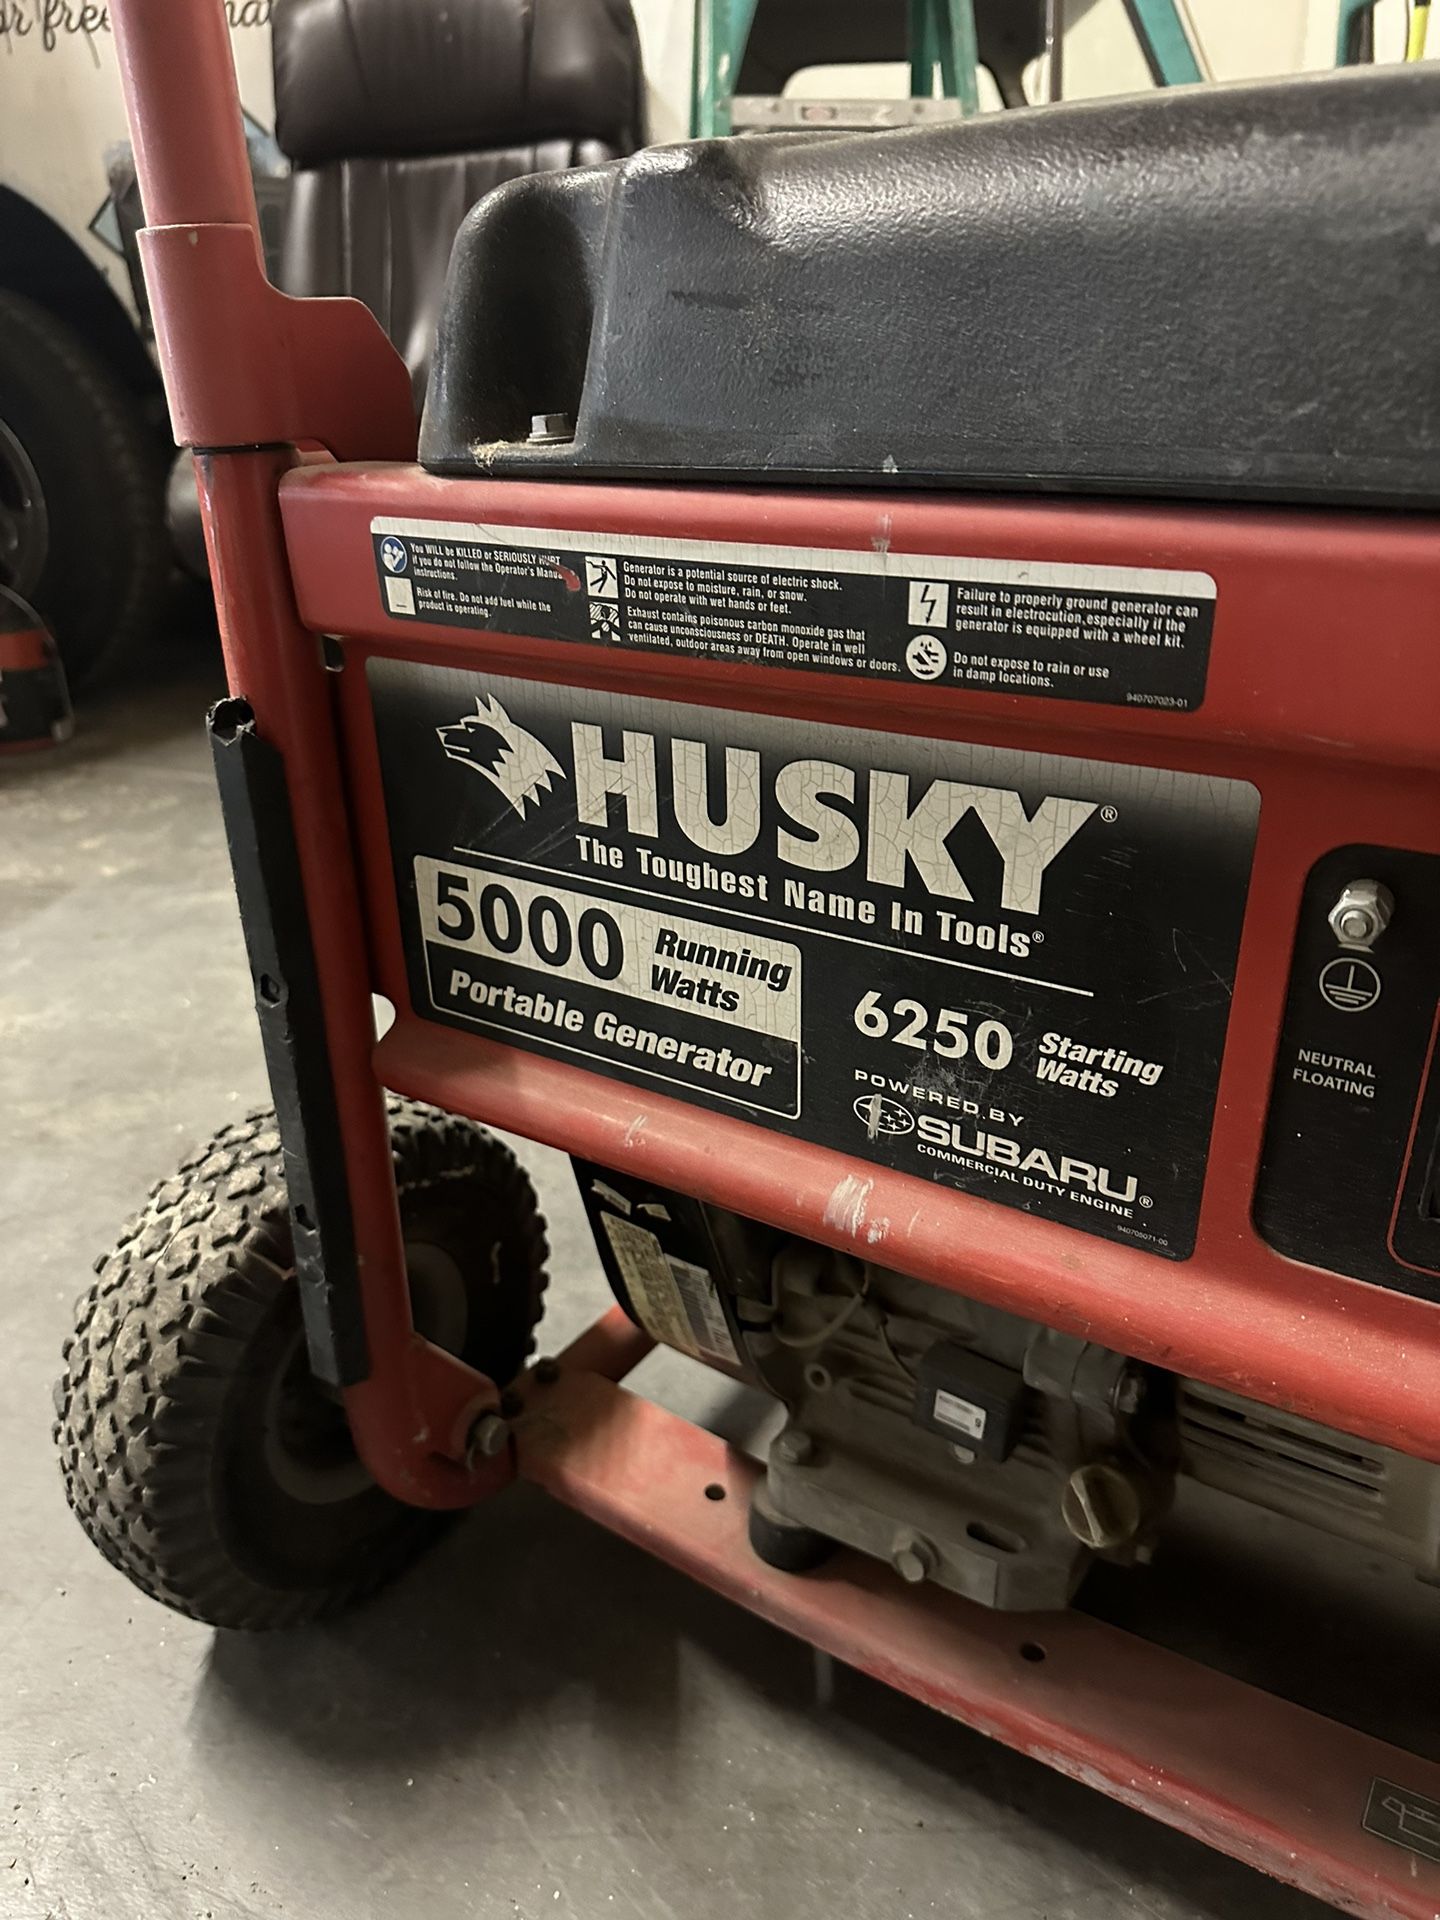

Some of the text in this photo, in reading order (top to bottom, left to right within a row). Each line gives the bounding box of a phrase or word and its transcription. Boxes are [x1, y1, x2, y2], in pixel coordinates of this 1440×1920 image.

[536, 566, 563, 579] Manua
[623, 561, 842, 590] Generator is a potential source of electric shock.
[624, 575, 807, 602] Do not expose to moisture, rain, or snow.
[625, 588, 792, 614] Do not operate with wet hands or feet.
[956, 604, 988, 616] result
[991, 605, 1002, 617] in
[1153, 617, 1162, 630] if
[1166, 618, 1186, 633] the
[957, 587, 1199, 618] Failure to properly ground generator can
[627, 606, 865, 641] Exhaust contains poisonous carbon monoxide gas that
[628, 620, 865, 655] can cause unconsciousness or DEATH. Operate in well
[955, 618, 1184, 648] generator is equipped with a wheel kit.
[628, 633, 901, 672] ventilated, outdoor areas away from open windows or doors.
[954, 651, 1110, 678] Do not expose to rain or use
[953, 666, 1054, 688] in damp locations.
[575, 834, 624, 870] The
[636, 846, 769, 903] Toughest
[784, 878, 877, 926] Name
[890, 902, 924, 936] In
[436, 870, 625, 982] 5000
[654, 928, 793, 992] Running
[650, 964, 742, 1012] Watts
[449, 968, 774, 1089] Portable Generator
[854, 990, 1014, 1071] 6250
[1038, 1031, 1165, 1086] Starting
[1298, 1048, 1377, 1078] NEUTRAL
[1036, 1057, 1120, 1098] Watts
[1292, 1068, 1376, 1098] FLOATING
[854, 1068, 1025, 1128] POWERED BY
[917, 1143, 1135, 1220] COMMERCIAL DUTY ENGINE
